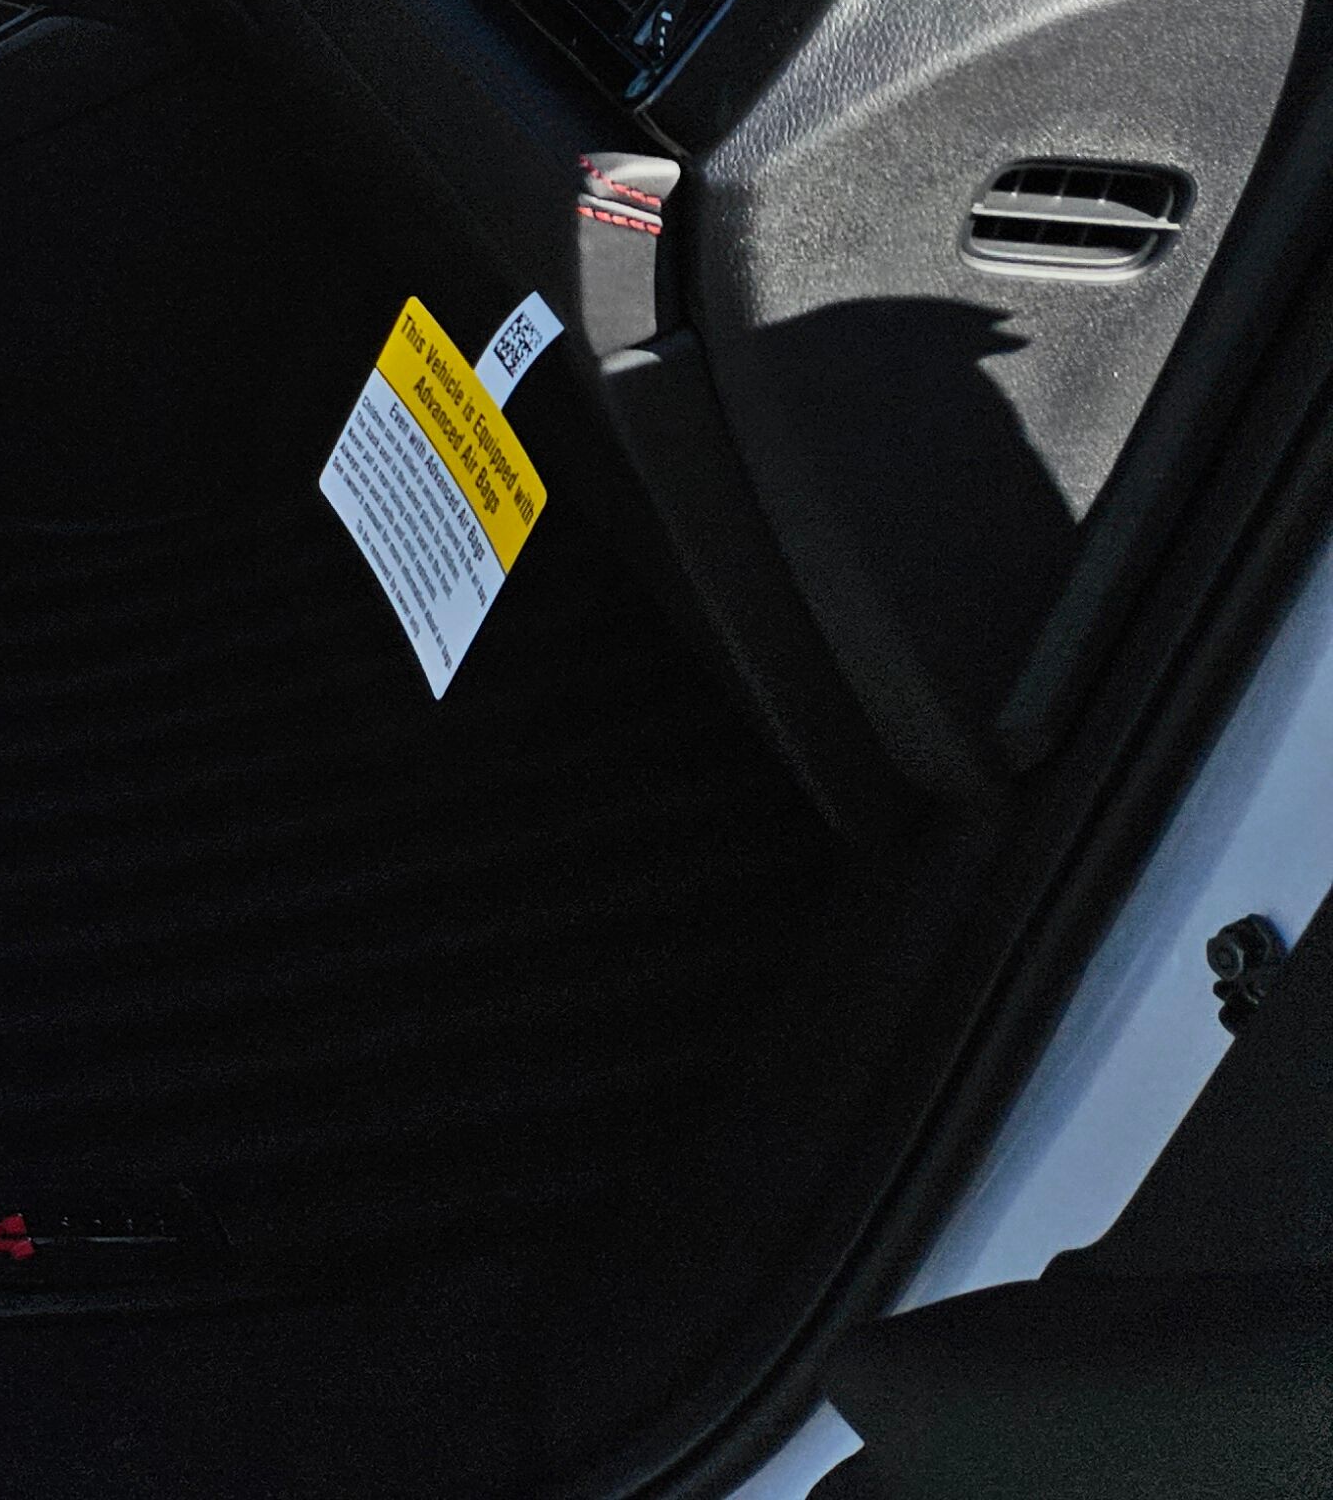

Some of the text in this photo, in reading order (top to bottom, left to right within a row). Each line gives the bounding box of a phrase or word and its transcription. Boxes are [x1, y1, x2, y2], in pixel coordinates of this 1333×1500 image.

[389, 402, 484, 561] Even with Advanced Air Bags
[401, 313, 533, 525] This Vehicle is Equipped with
[413, 376, 499, 513] Advanced Air Bags
